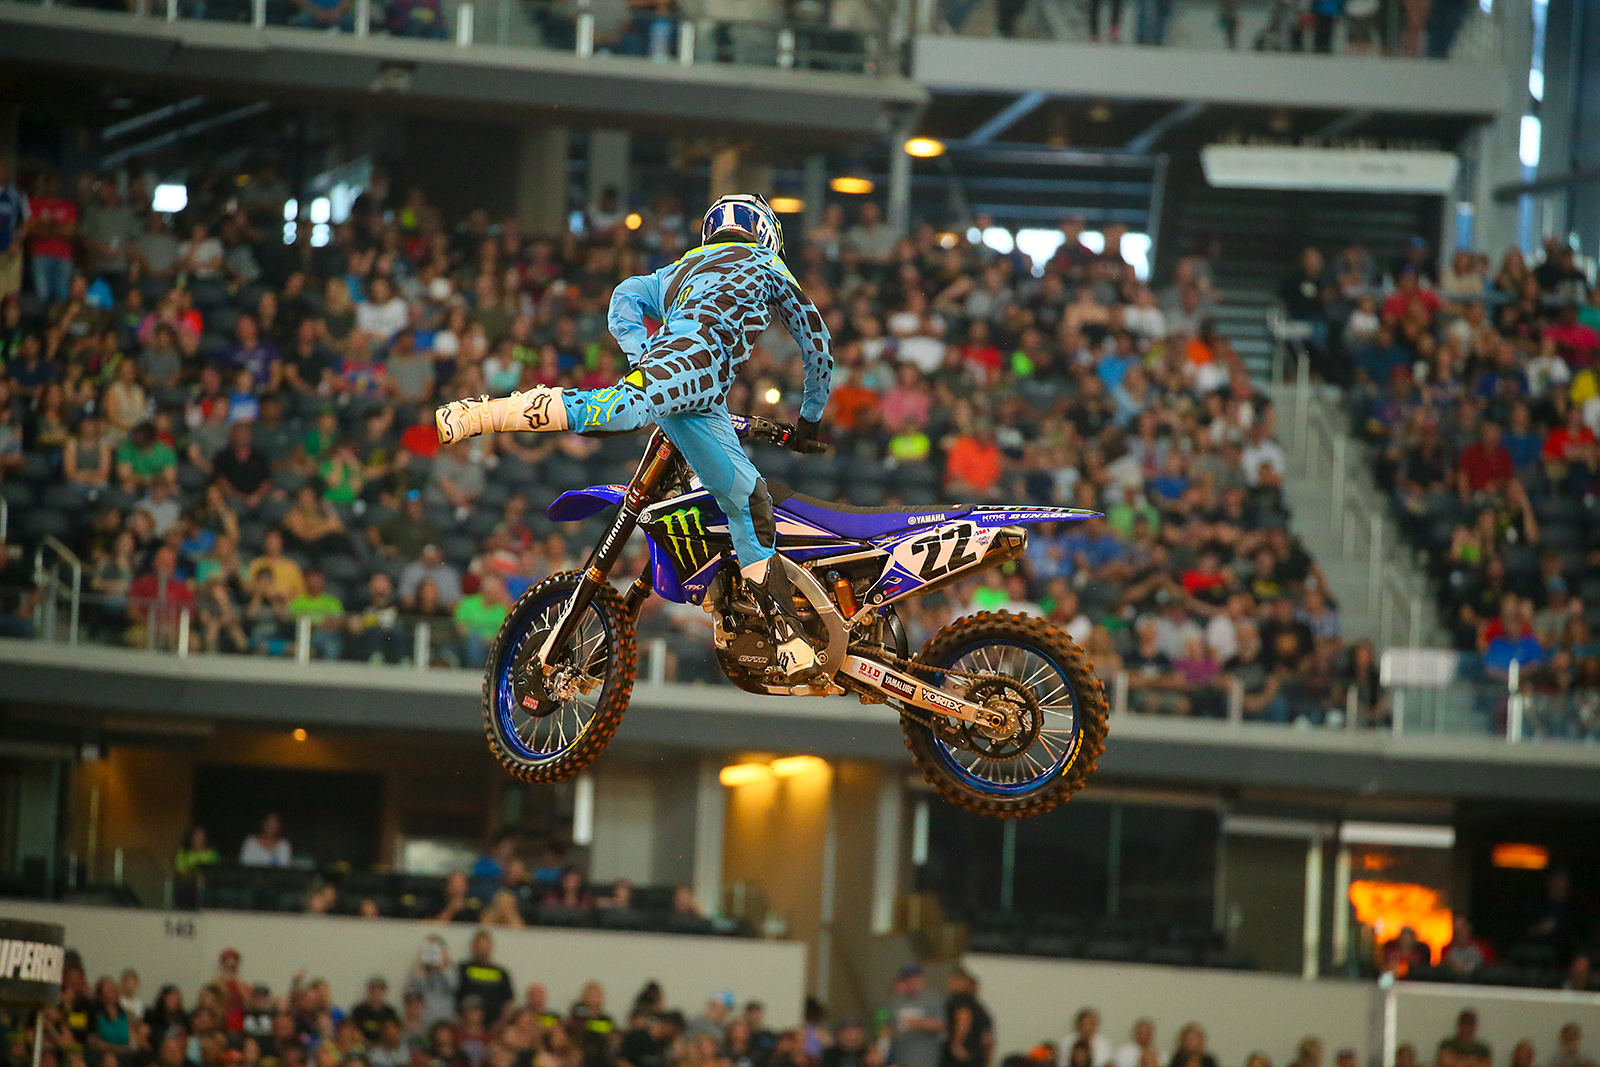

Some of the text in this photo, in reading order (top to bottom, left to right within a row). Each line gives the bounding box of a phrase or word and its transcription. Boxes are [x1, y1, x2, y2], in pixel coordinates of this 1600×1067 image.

[916, 513, 946, 524] YAMAHA
[1008, 512, 1073, 520] DUNLOP
[598, 511, 628, 560] YAMAHA
[911, 523, 978, 582] 22
[884, 674, 916, 696] YAMALUBE
[922, 687, 965, 714] VORTEX
